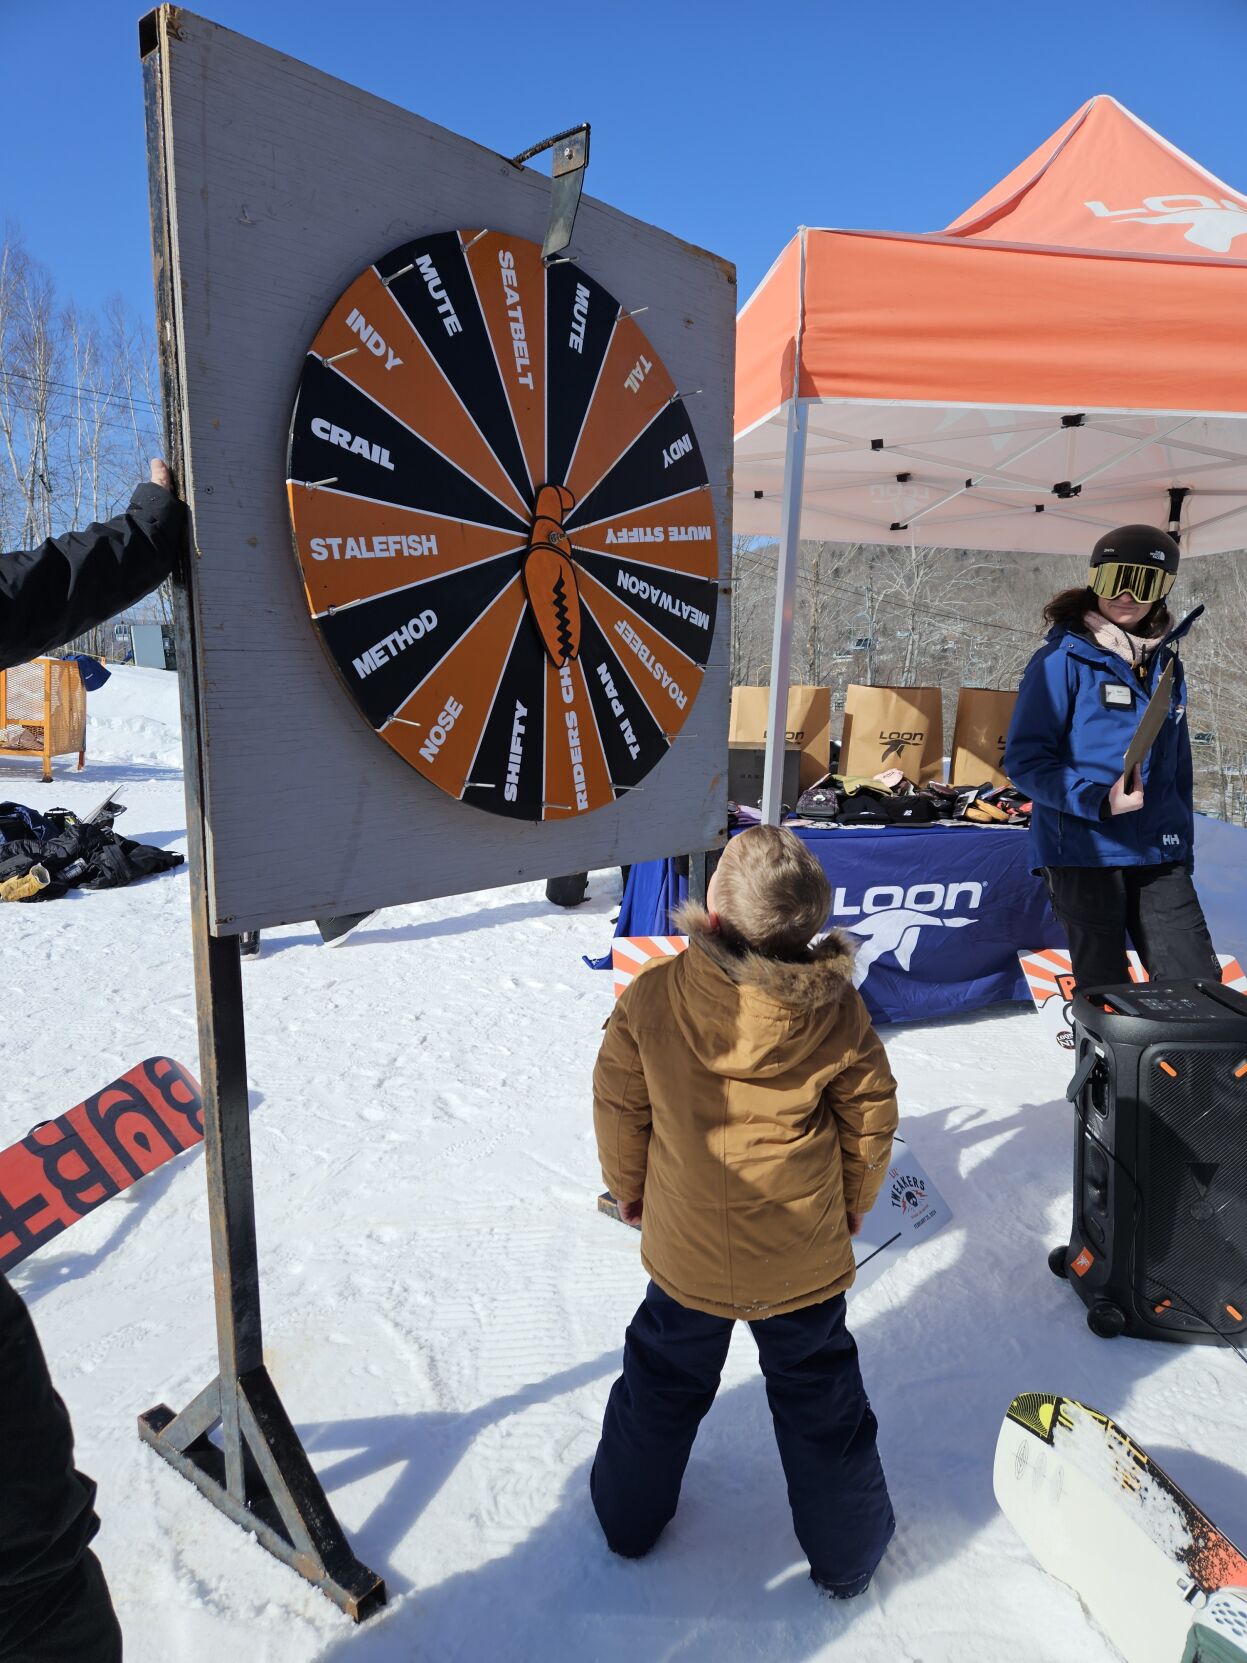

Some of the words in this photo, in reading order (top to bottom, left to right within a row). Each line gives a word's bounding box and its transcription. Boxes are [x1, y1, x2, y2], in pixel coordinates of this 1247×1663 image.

[1083, 194, 1247, 218] LO
[415, 253, 464, 337] MUTE
[498, 249, 534, 391] SEATBELT
[568, 282, 591, 354] MUTE
[345, 308, 404, 371] INDY
[623, 354, 653, 394] TAIL
[310, 417, 395, 471] CRAIL
[661, 432, 693, 469] INDY
[309, 534, 439, 561] STALEFISH
[605, 526, 665, 544] STIFFY
[668, 525, 712, 542] MUTE
[616, 569, 710, 631] MEATWAGON
[351, 608, 438, 680] METHOD
[613, 620, 688, 711] ROASTBEEF
[558, 658, 575, 704] CH
[596, 662, 625, 718] PAN
[418, 695, 464, 764] NOSE
[503, 699, 529, 802] SHIFTY
[619, 717, 641, 761] TAI
[763, 730, 805, 741] ON
[878, 730, 924, 742] LOON
[565, 710, 589, 811] RIDERS
[833, 880, 983, 916] LOON
[891, 1175, 925, 1208] TWEAKERS
